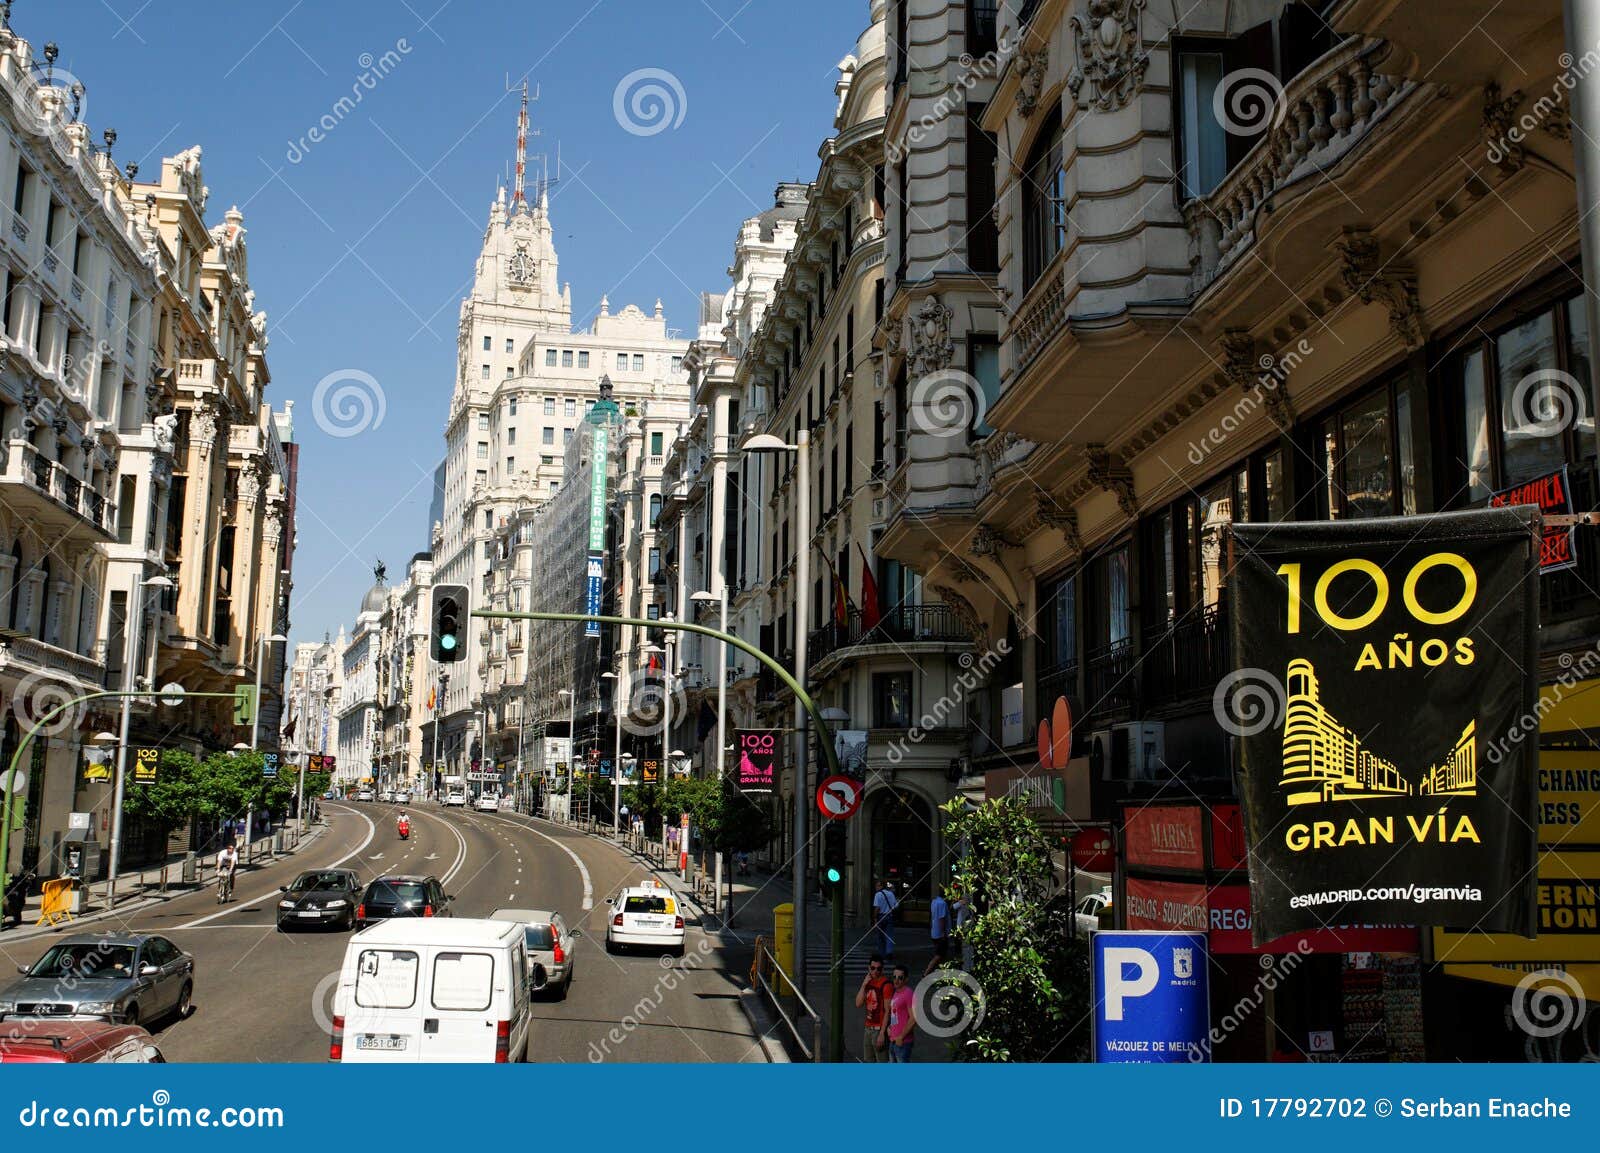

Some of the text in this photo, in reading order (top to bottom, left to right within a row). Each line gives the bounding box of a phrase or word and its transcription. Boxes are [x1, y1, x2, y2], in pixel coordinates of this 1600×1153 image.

[1276, 552, 1478, 634] 100
[1354, 633, 1476, 671] AÑOS
[136, 749, 158, 758] 100
[741, 735, 774, 747] 100
[1150, 823, 1196, 849] MARISA
[1285, 807, 1481, 851] GRAN VÍA
[1289, 883, 1482, 909] esMADRID.com/granvia
[1126, 895, 1158, 920] REGALOS
[1162, 901, 1208, 930] SOUVENIRS
[1536, 907, 1597, 929] ION
[1104, 947, 1160, 1021] P
[1106, 1039, 1149, 1052] VÁZQUEZ
[1152, 1041, 1165, 1052] DE
